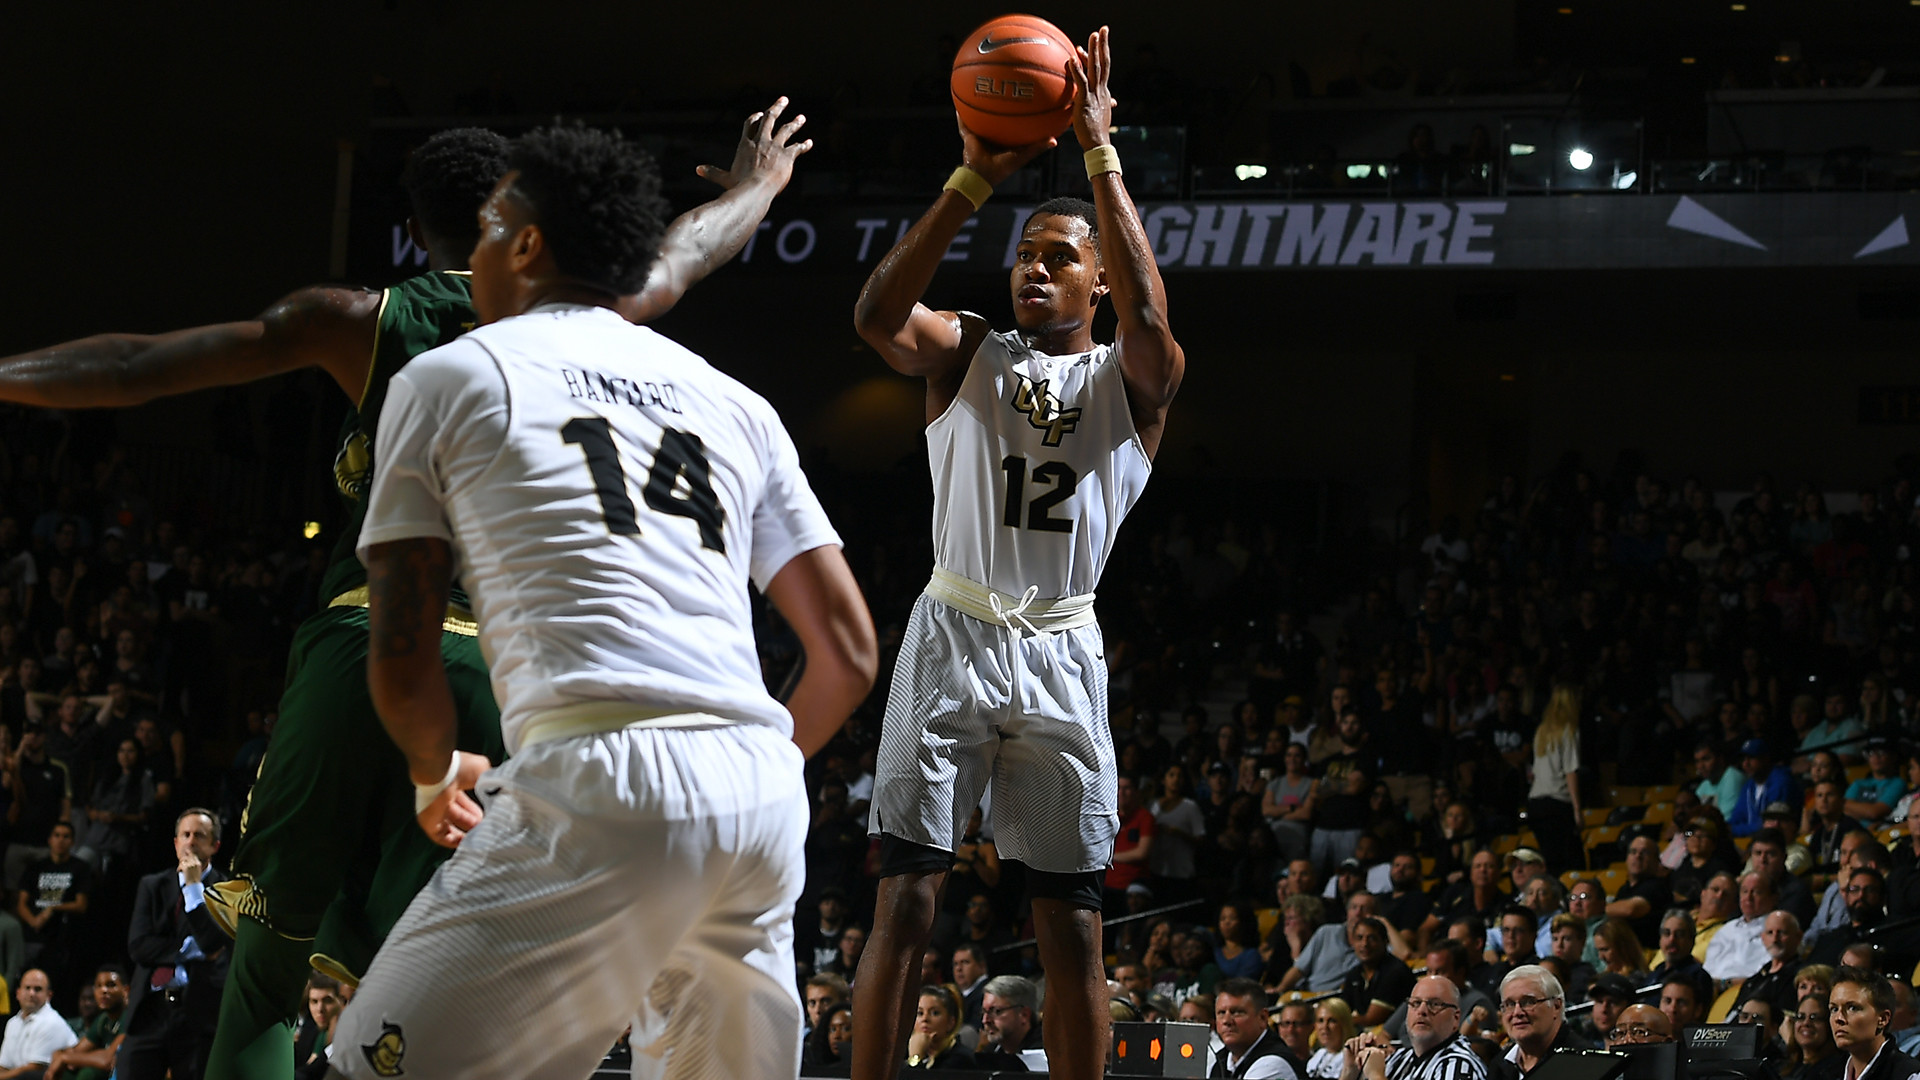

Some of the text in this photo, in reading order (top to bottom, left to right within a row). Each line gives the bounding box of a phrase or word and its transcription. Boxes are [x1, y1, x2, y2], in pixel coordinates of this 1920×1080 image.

[974, 76, 1035, 98] ELITE
[855, 219, 979, 263] TE
[1002, 202, 1508, 268] GHTMARE
[1011, 372, 1082, 448] UCF
[560, 417, 726, 554] 14
[1002, 455, 1077, 533] 12
